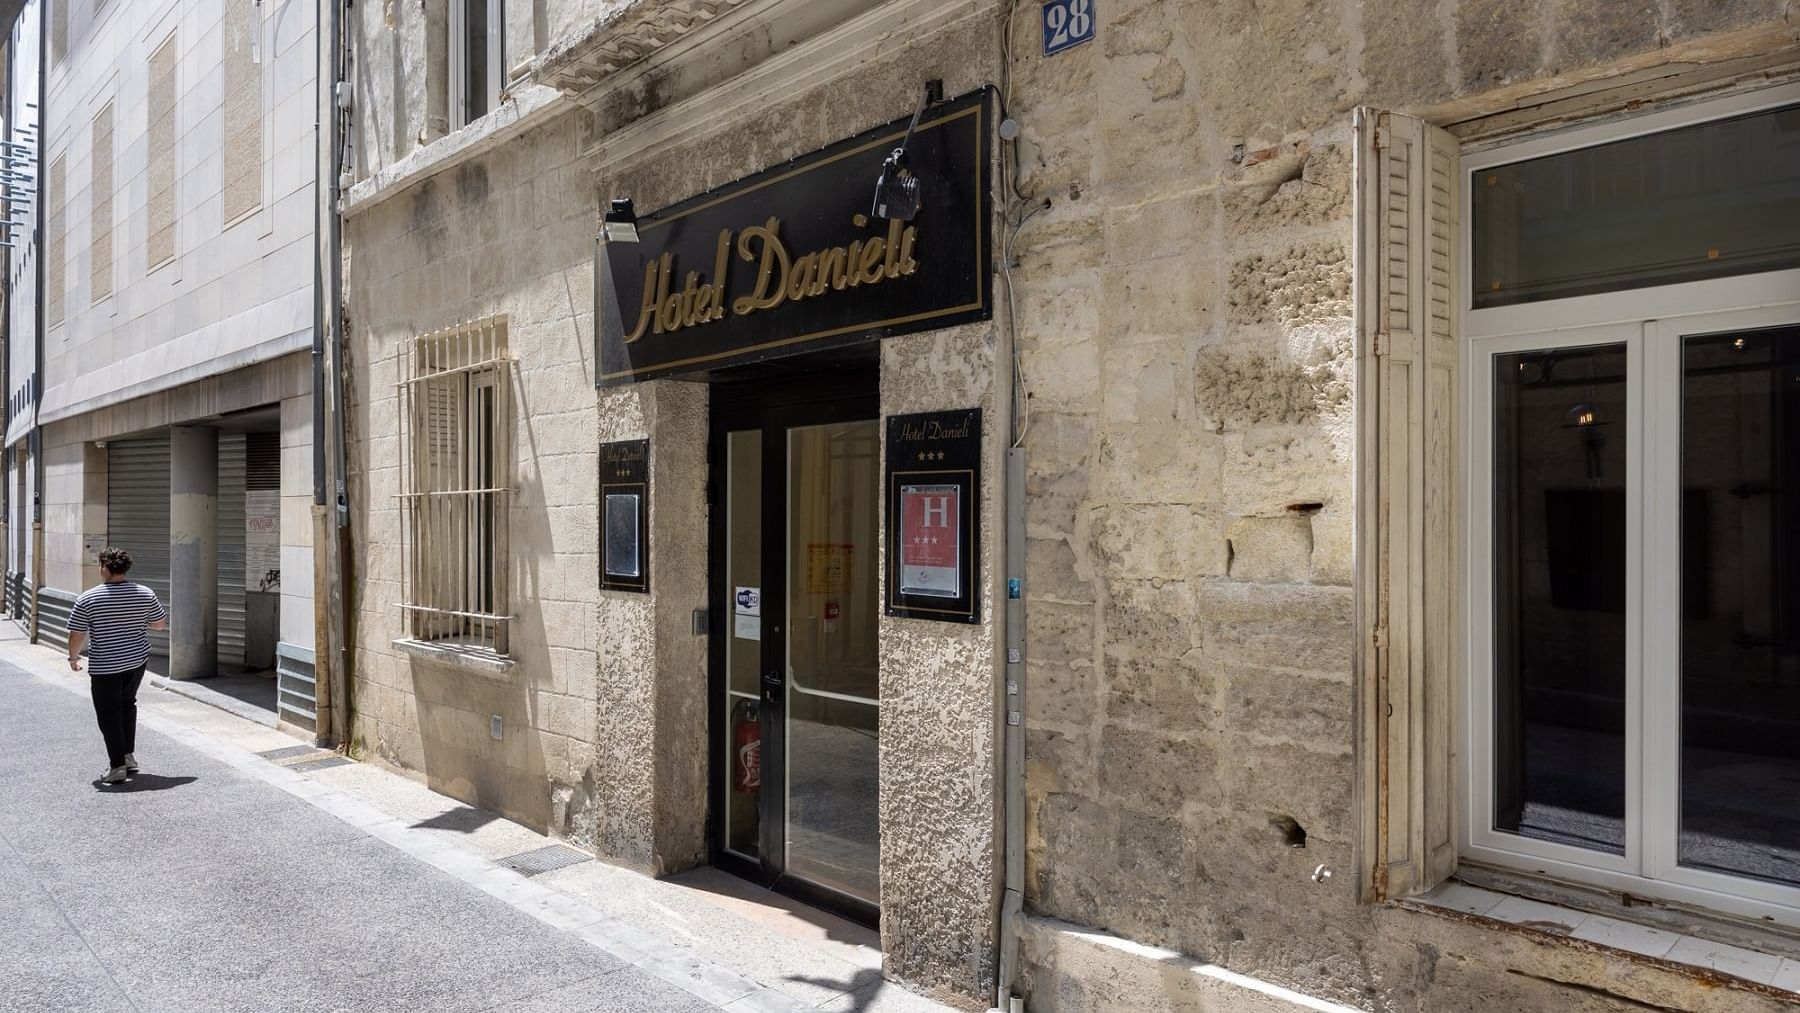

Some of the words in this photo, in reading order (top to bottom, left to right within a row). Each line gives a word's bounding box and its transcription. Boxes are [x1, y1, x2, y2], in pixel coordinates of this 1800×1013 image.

[1047, 0, 1090, 48] 28
[624, 228, 732, 343] Hotel
[733, 208, 920, 315] Danieli
[897, 420, 926, 441] Hotel
[928, 418, 969, 440] Danieli
[923, 496, 948, 528] H
